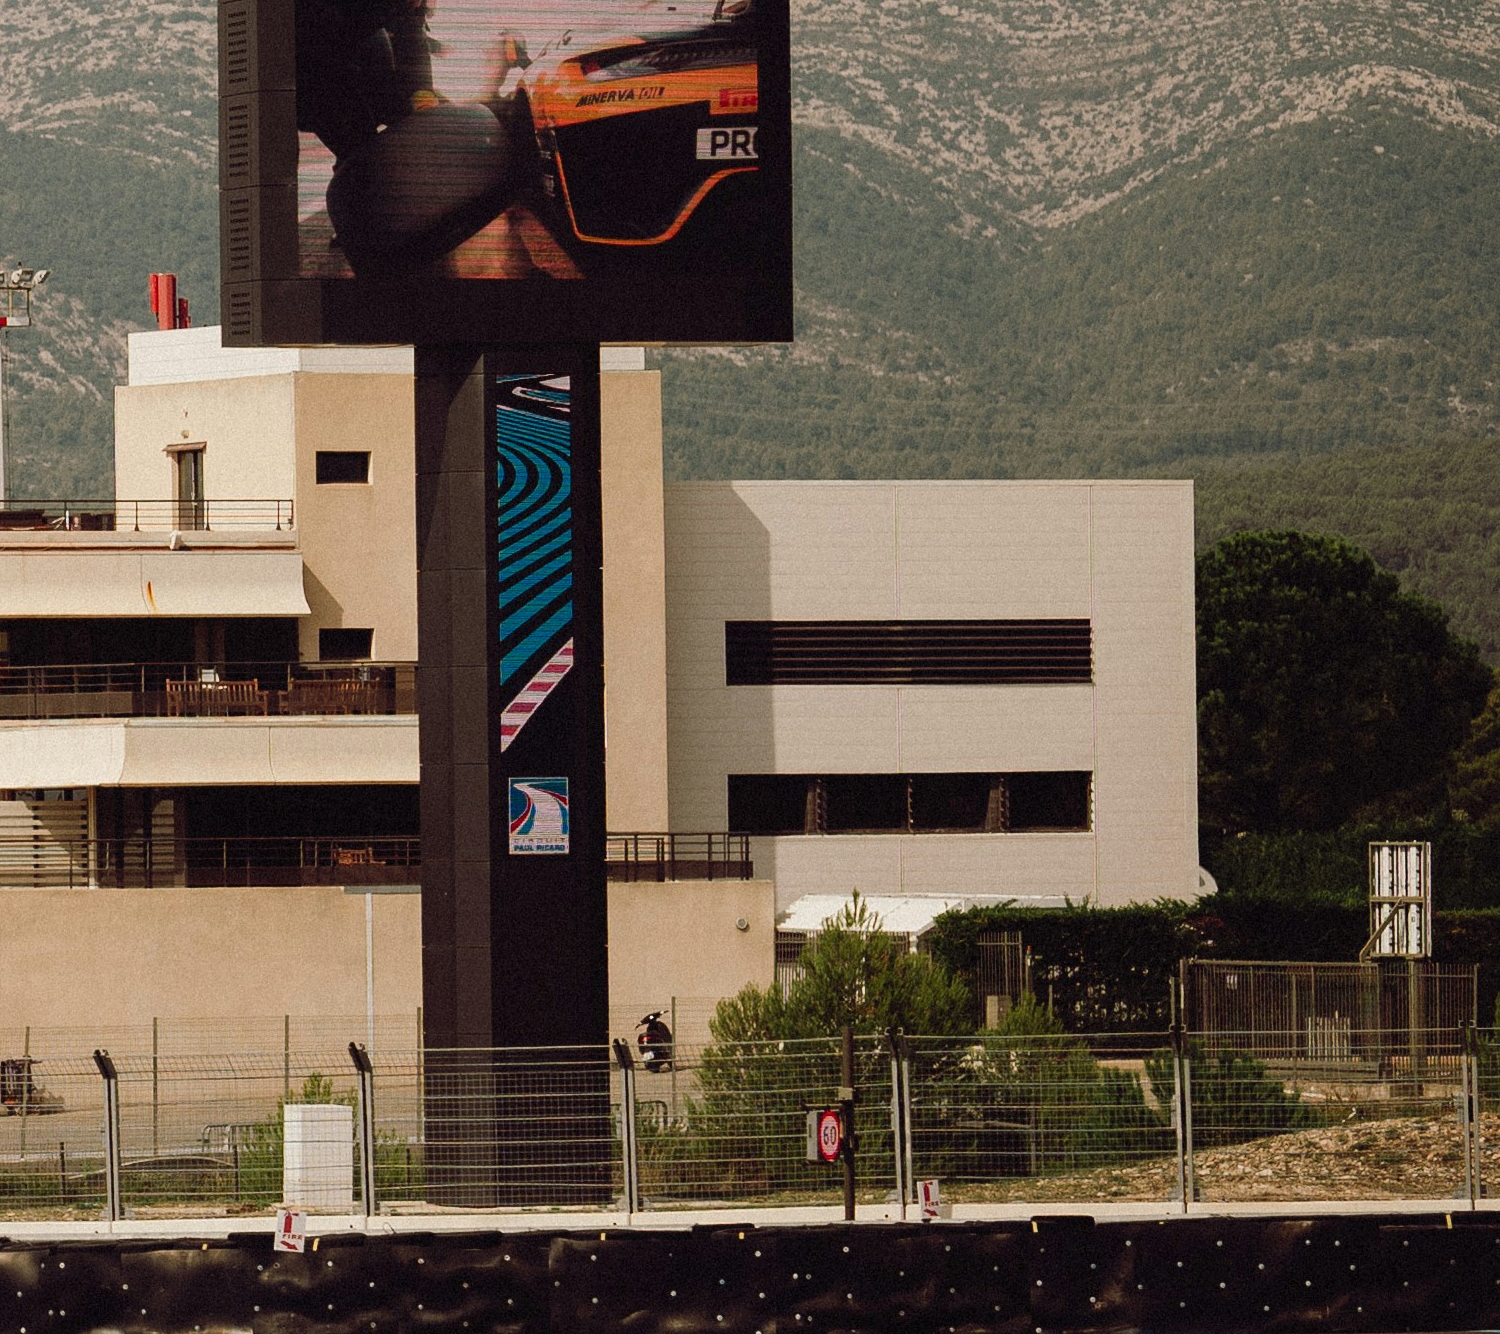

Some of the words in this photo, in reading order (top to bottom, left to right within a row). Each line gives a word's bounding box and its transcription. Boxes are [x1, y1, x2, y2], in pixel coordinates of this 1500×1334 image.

[575, 88, 635, 107] MINERVA
[710, 130, 758, 156] PR
[536, 844, 566, 852] RICARD
[823, 1125, 837, 1146] 60
